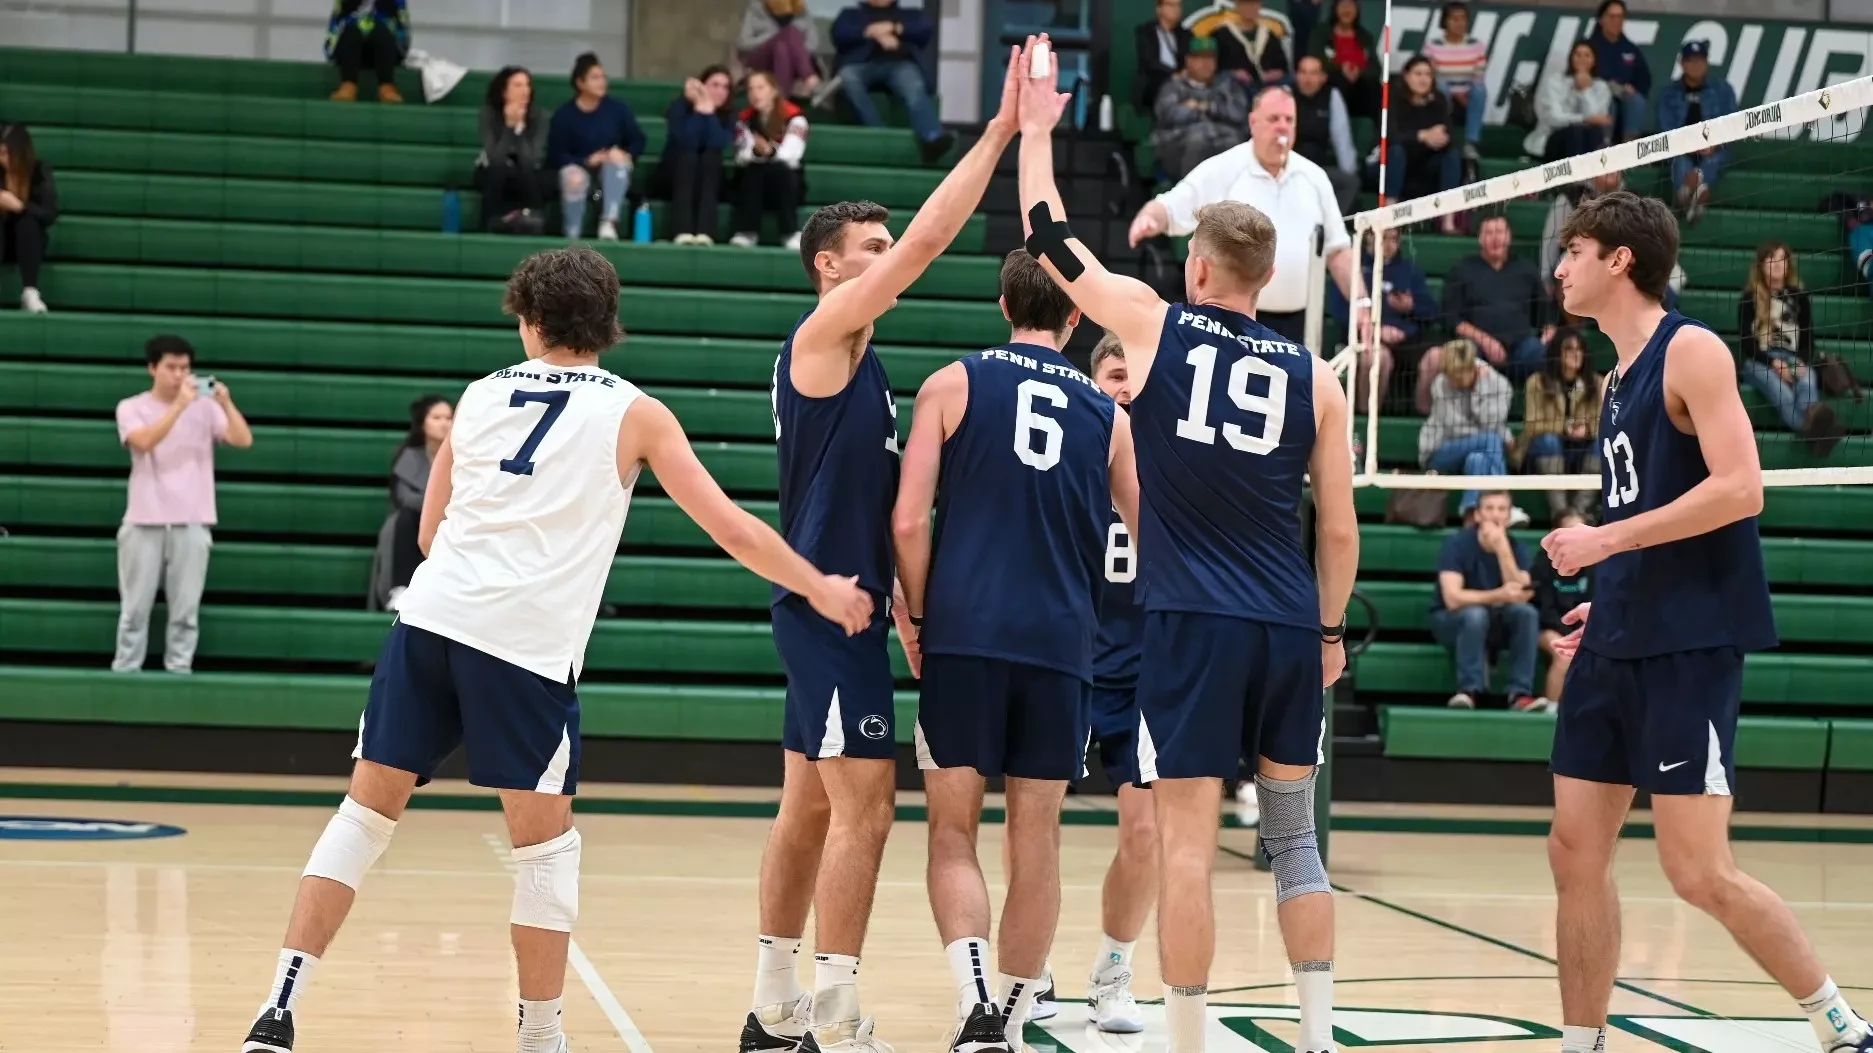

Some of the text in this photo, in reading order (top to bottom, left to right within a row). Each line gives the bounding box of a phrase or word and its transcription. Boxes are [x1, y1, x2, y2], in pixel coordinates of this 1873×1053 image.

[546, 371, 617, 389] STATE
[981, 349, 1102, 394] PENN STATE
[1236, 335, 1301, 357] STATE
[499, 388, 571, 477] 7
[1013, 378, 1069, 472] 6
[1176, 343, 1289, 456] 19
[1603, 430, 1640, 508] 13
[1104, 522, 1138, 584] 8
